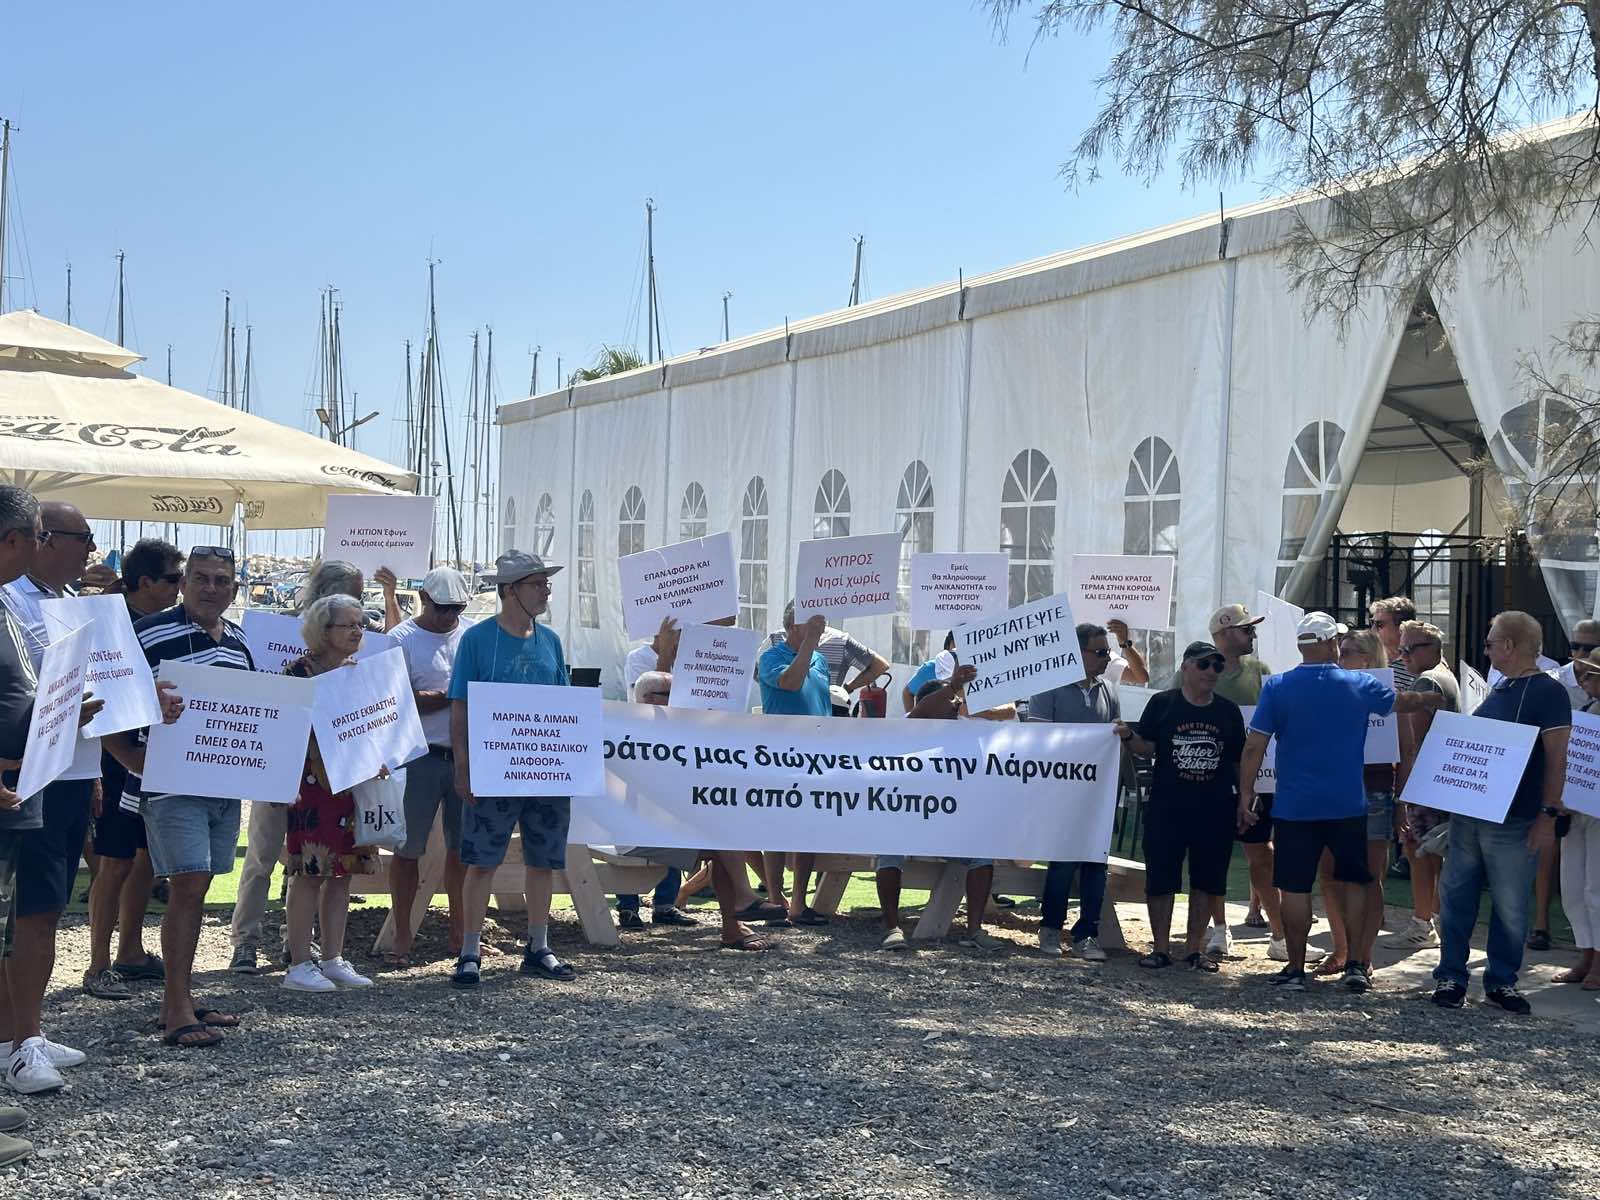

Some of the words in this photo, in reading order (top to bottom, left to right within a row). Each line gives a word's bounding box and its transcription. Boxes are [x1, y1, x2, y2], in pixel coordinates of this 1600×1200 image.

[384, 528, 408, 538] Έφυγε
[351, 538, 384, 549] αυξήσεις
[385, 539, 414, 548] έμειναν
[825, 553, 873, 568] ΚΥΠΡΟΣ
[950, 564, 969, 572] Εμείς
[644, 562, 696, 582] ΕΠΑΝΑΦΟΡΑ
[697, 559, 710, 569] ΚΑΙ
[942, 573, 986, 583] πληρώσουμε
[1090, 574, 1124, 582] ΑΝΙΚΑΝΟ
[657, 574, 700, 590] ΔΙΟΡΘΩΣΗ
[814, 575, 844, 590] Νησί
[846, 572, 880, 587] χωρίς
[635, 593, 662, 606] ΤΕΛΩΝ
[663, 578, 725, 600] ΕΛΛΙΜΕΝΙΣΜΟΥ
[938, 593, 980, 601] ΥΠΟΥΡΓΕΙΟΥ
[1098, 593, 1139, 601] ΕΞΑΠΑΤΗΣΗ
[670, 598, 692, 609] ΤΩΡΑ
[801, 593, 847, 609] ναυτικό
[850, 591, 890, 605] όραμα
[934, 604, 983, 612] ΜΕΤΑΦΟΡΩΝ;
[712, 639, 728, 649] Εμείς
[968, 648, 997, 665] ΤΗΝ
[1004, 630, 1060, 657] ΝΑΥΤΙΚΗ
[695, 650, 703, 659] θα
[704, 651, 739, 663] πληρώσουμε
[684, 663, 694, 672] την
[694, 663, 735, 675] ΑΝΙΚΑΝΟΤΗΤΑ
[967, 652, 1077, 696] ΔΡΑΣΤΗΡΙΟΤΗΤΑ
[696, 676, 729, 687] ΥΠΟΥΡΓΕΙΟΥ
[189, 699, 218, 712] ΕΣΕΙΣ
[221, 703, 261, 718] ΧΑΣΑΤΕ
[264, 708, 280, 720] ΤΙΣ
[331, 710, 361, 729] ΚΡΑΤΟΣ
[360, 696, 397, 718] ΕΚΒΙΑΣΤΗΣ
[206, 718, 259, 734] ΕΓΓΥΗΣΕΙΣ
[492, 712, 532, 723] ΜΑΡΙΝΑ
[533, 713, 541, 723] &
[543, 714, 578, 725] ΛΙΜΑΝΙ
[338, 724, 366, 743] ΚΡΑΤΟΣ
[367, 711, 399, 732] ΑΝΙΚΑΝΟ
[511, 727, 561, 738] ΛΑΡΝΑΚΑΣ
[195, 734, 228, 748] ΕΜΕΙΣ
[230, 738, 247, 749] ΘΑ
[250, 740, 263, 751] ΤΑ
[484, 741, 538, 752] ΤΕΡΜΑΤΙΚΟ
[540, 742, 588, 754] ΒΑΣΙΛΙΚΟΥ
[1445, 738, 1464, 749] ΕΣΕΙΣ
[1465, 742, 1494, 754] ΧΑΣΑΤΕ
[1494, 747, 1506, 756] ΤΙΣ
[186, 751, 267, 770] ΠΛΗΡΩΣΟΥΜΕ;
[510, 756, 565, 767] ΔΙΑΦΘΟΡΑ-
[695, 746, 748, 770] μας
[754, 745, 862, 775] διώχνει
[868, 753, 923, 773] απο
[929, 756, 977, 780] την
[985, 752, 1097, 783] Λάρνακα
[1452, 752, 1489, 766] ΕΓΓΥΗΣΕΙΣ
[503, 770, 572, 782] ΑΝΙΚΑΝΟΤΗΤΑ
[1442, 763, 1465, 775] ΕΜΕΙΣ
[1465, 768, 1477, 777] ΘΑ
[1478, 771, 1488, 779] ΤΑ
[1433, 774, 1488, 794] ΠΛΗΡΩΣΟΥΜΕ;
[692, 785, 738, 806] και
[745, 784, 802, 809] από
[810, 789, 859, 817] την
[867, 786, 957, 819] Κύπρο
[364, 804, 396, 832] BJX
